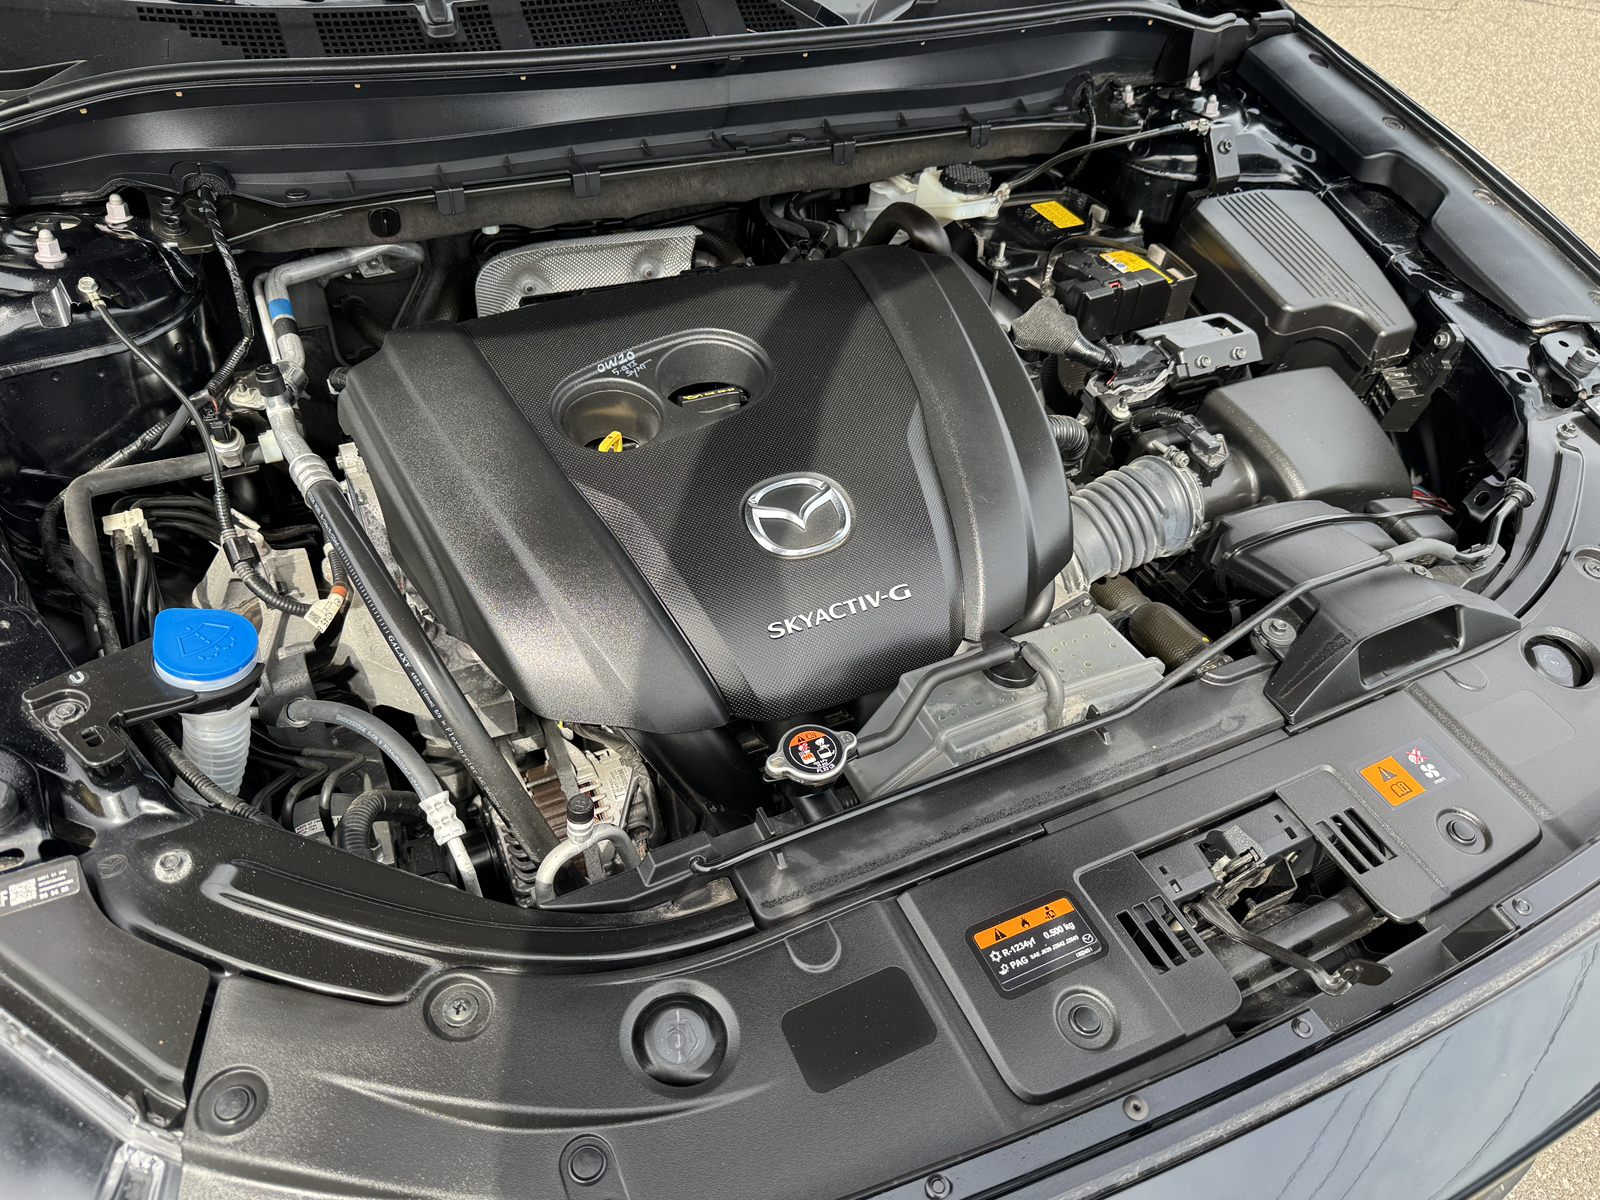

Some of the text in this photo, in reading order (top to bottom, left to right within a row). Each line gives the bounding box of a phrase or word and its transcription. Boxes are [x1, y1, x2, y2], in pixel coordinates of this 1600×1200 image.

[767, 583, 912, 639] SKYACTIV-G
[388, 635, 412, 668] GALAXY
[68, 671, 85, 684] U
[1001, 921, 1076, 957] R-1234yf 0.500 kg
[1009, 956, 1029, 970] PAG
